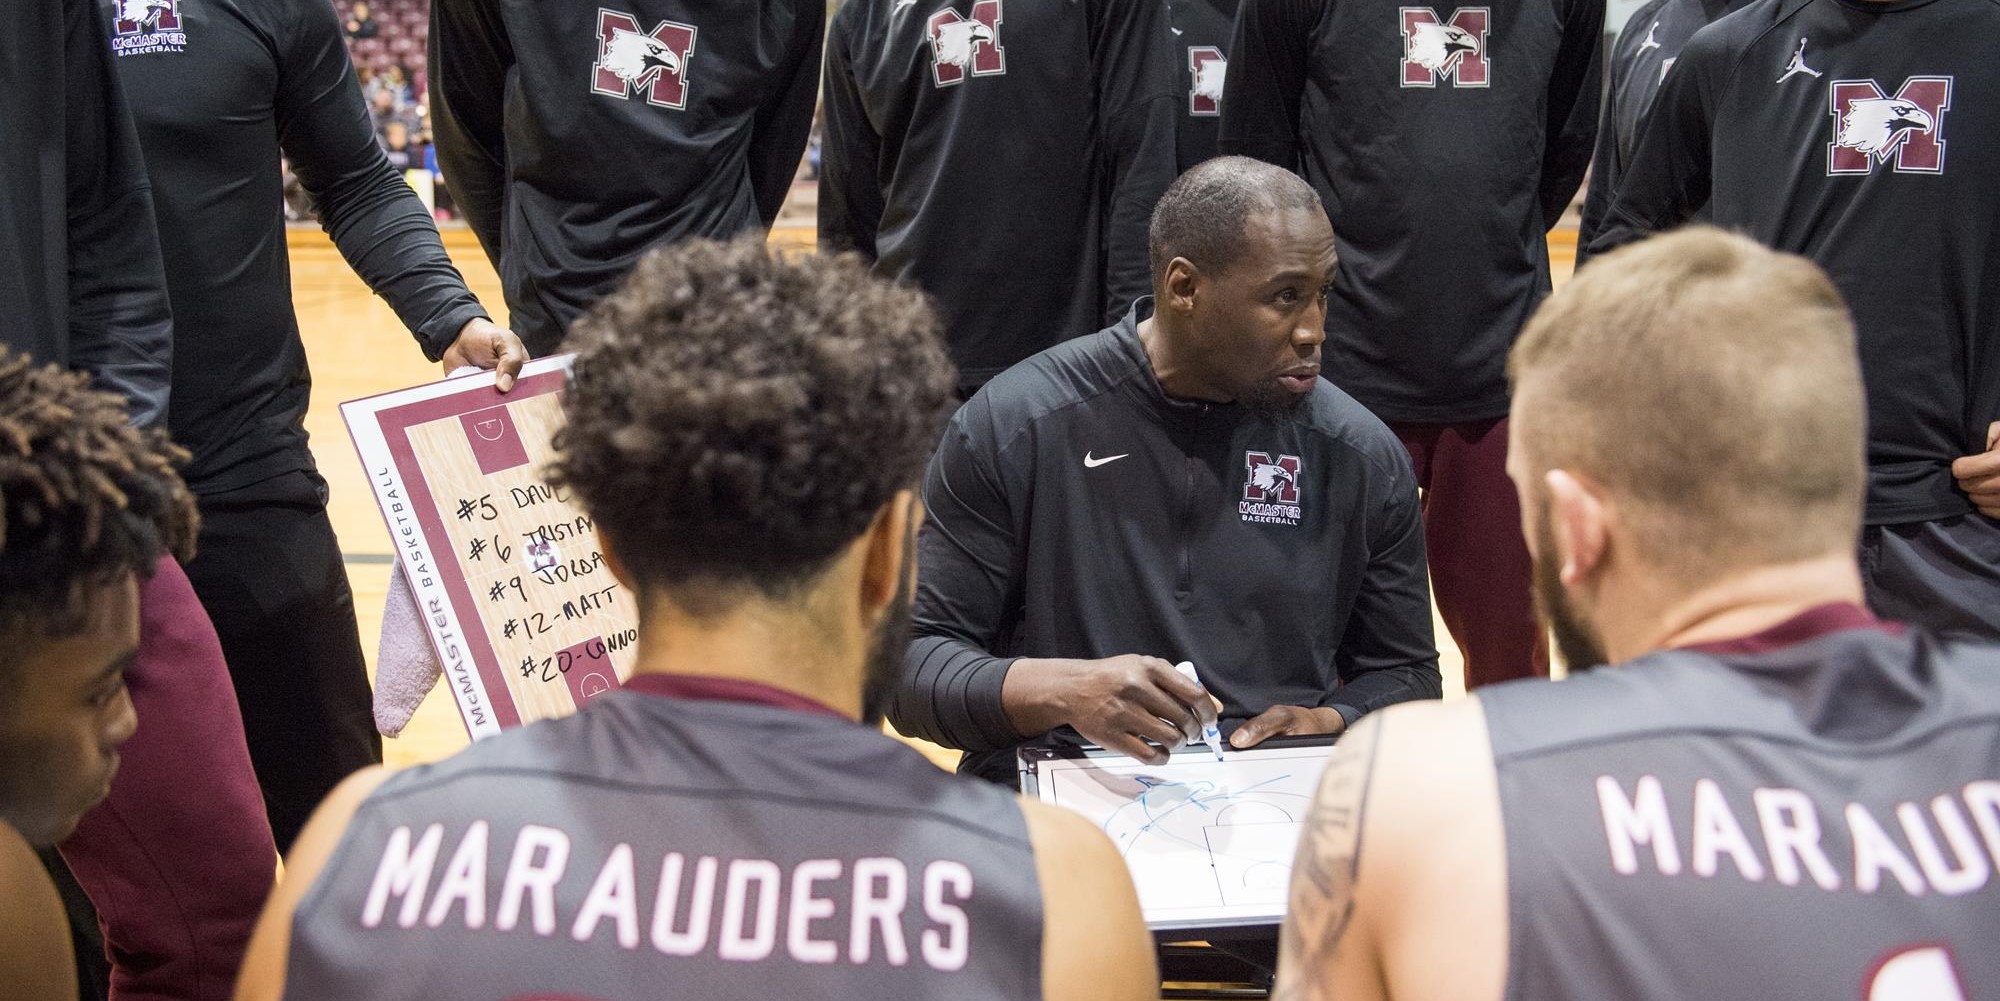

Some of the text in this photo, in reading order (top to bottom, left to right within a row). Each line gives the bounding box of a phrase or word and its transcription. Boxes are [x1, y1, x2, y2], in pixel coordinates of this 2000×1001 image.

[117, 45, 184, 57] BASKETBALL
[590, 7, 698, 111] M
[1399, 6, 1491, 89] M
[1826, 75, 1954, 177] M
[378, 467, 434, 588] BASKETBALL
[456, 494, 498, 521] #5
[1241, 514, 1298, 526] BASKETBALL
[469, 534, 511, 563] #6
[489, 576, 528, 602] #9
[531, 551, 607, 584] JORDA
[361, 818, 973, 972] MARAUDERS
